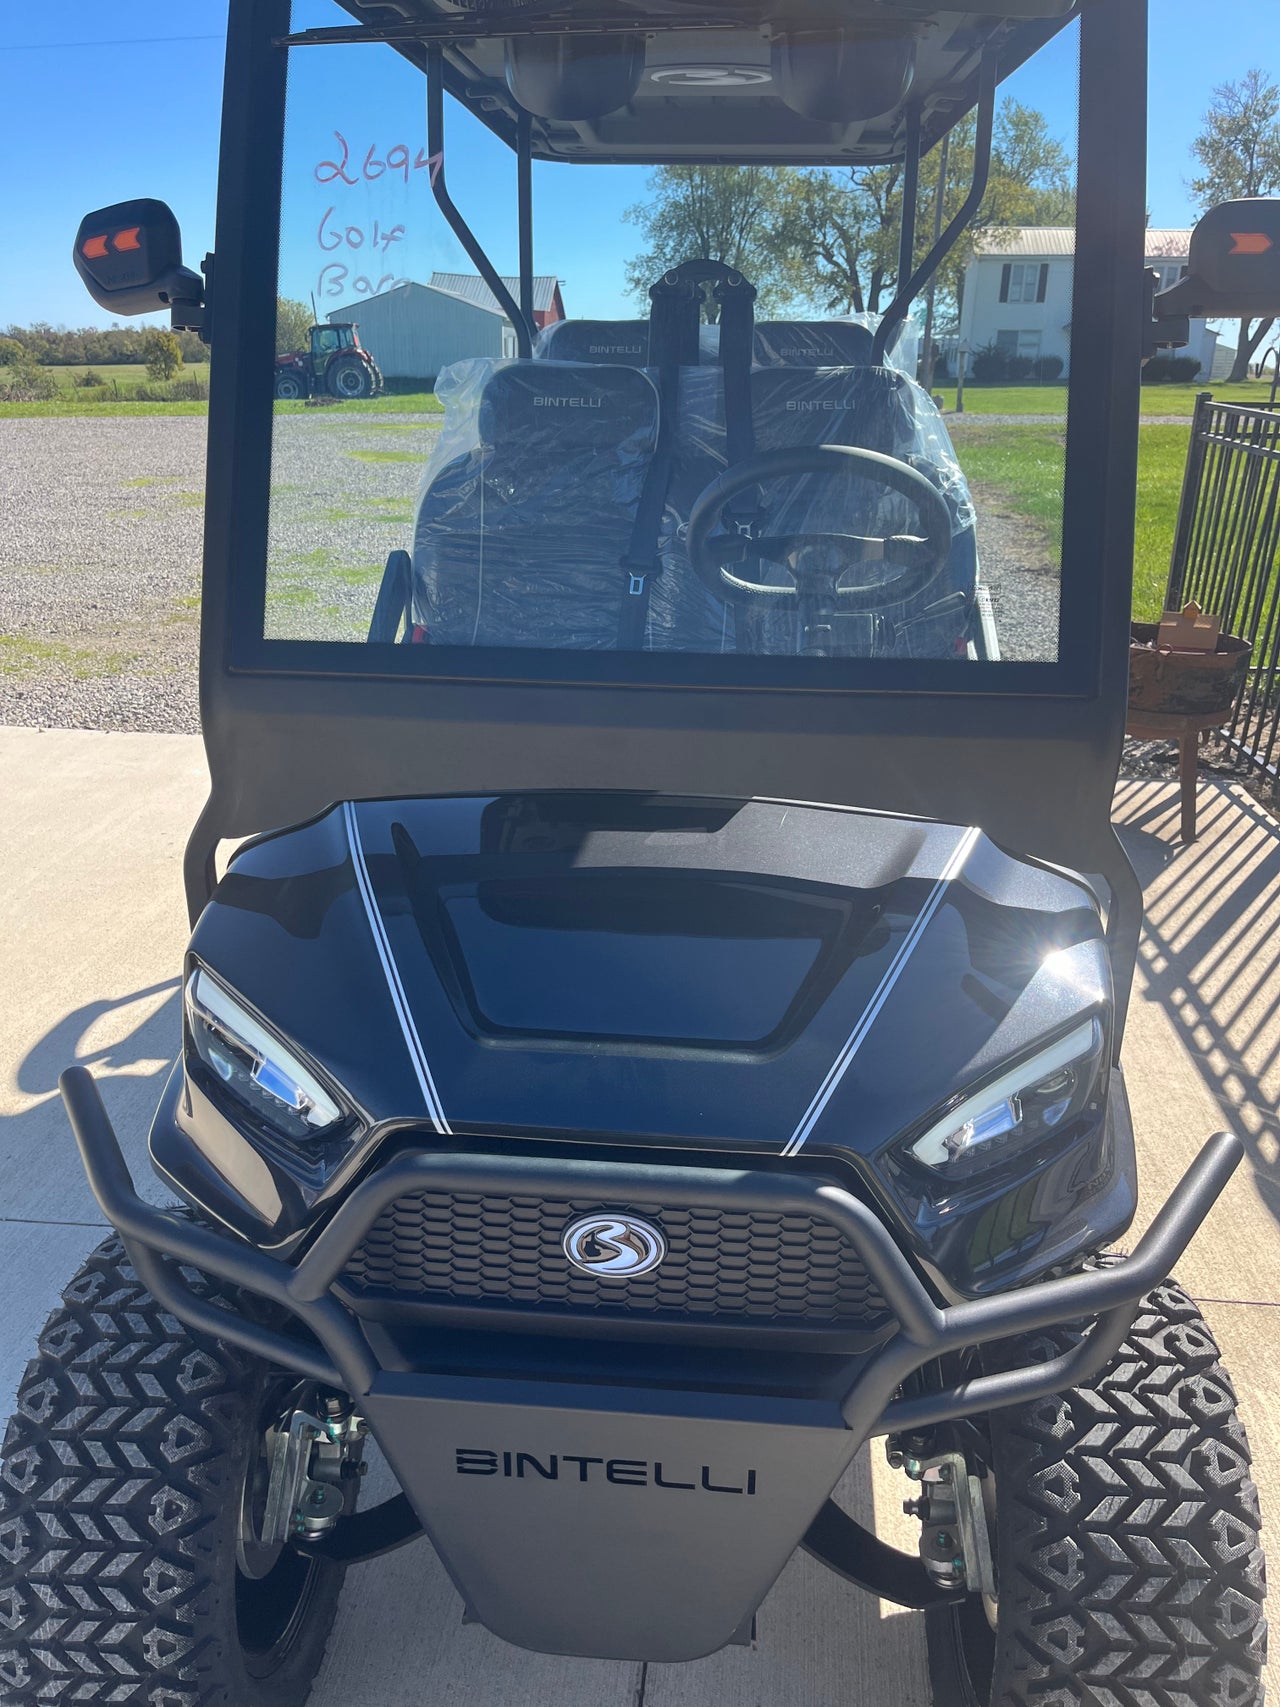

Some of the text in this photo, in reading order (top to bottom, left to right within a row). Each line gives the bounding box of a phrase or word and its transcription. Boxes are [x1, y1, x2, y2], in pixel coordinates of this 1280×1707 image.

[589, 345, 642, 354] BINTELLI
[533, 396, 602, 408] BINTELLI
[785, 400, 856, 411] BINTELLI
[455, 1447, 757, 1496] BINTELLI
